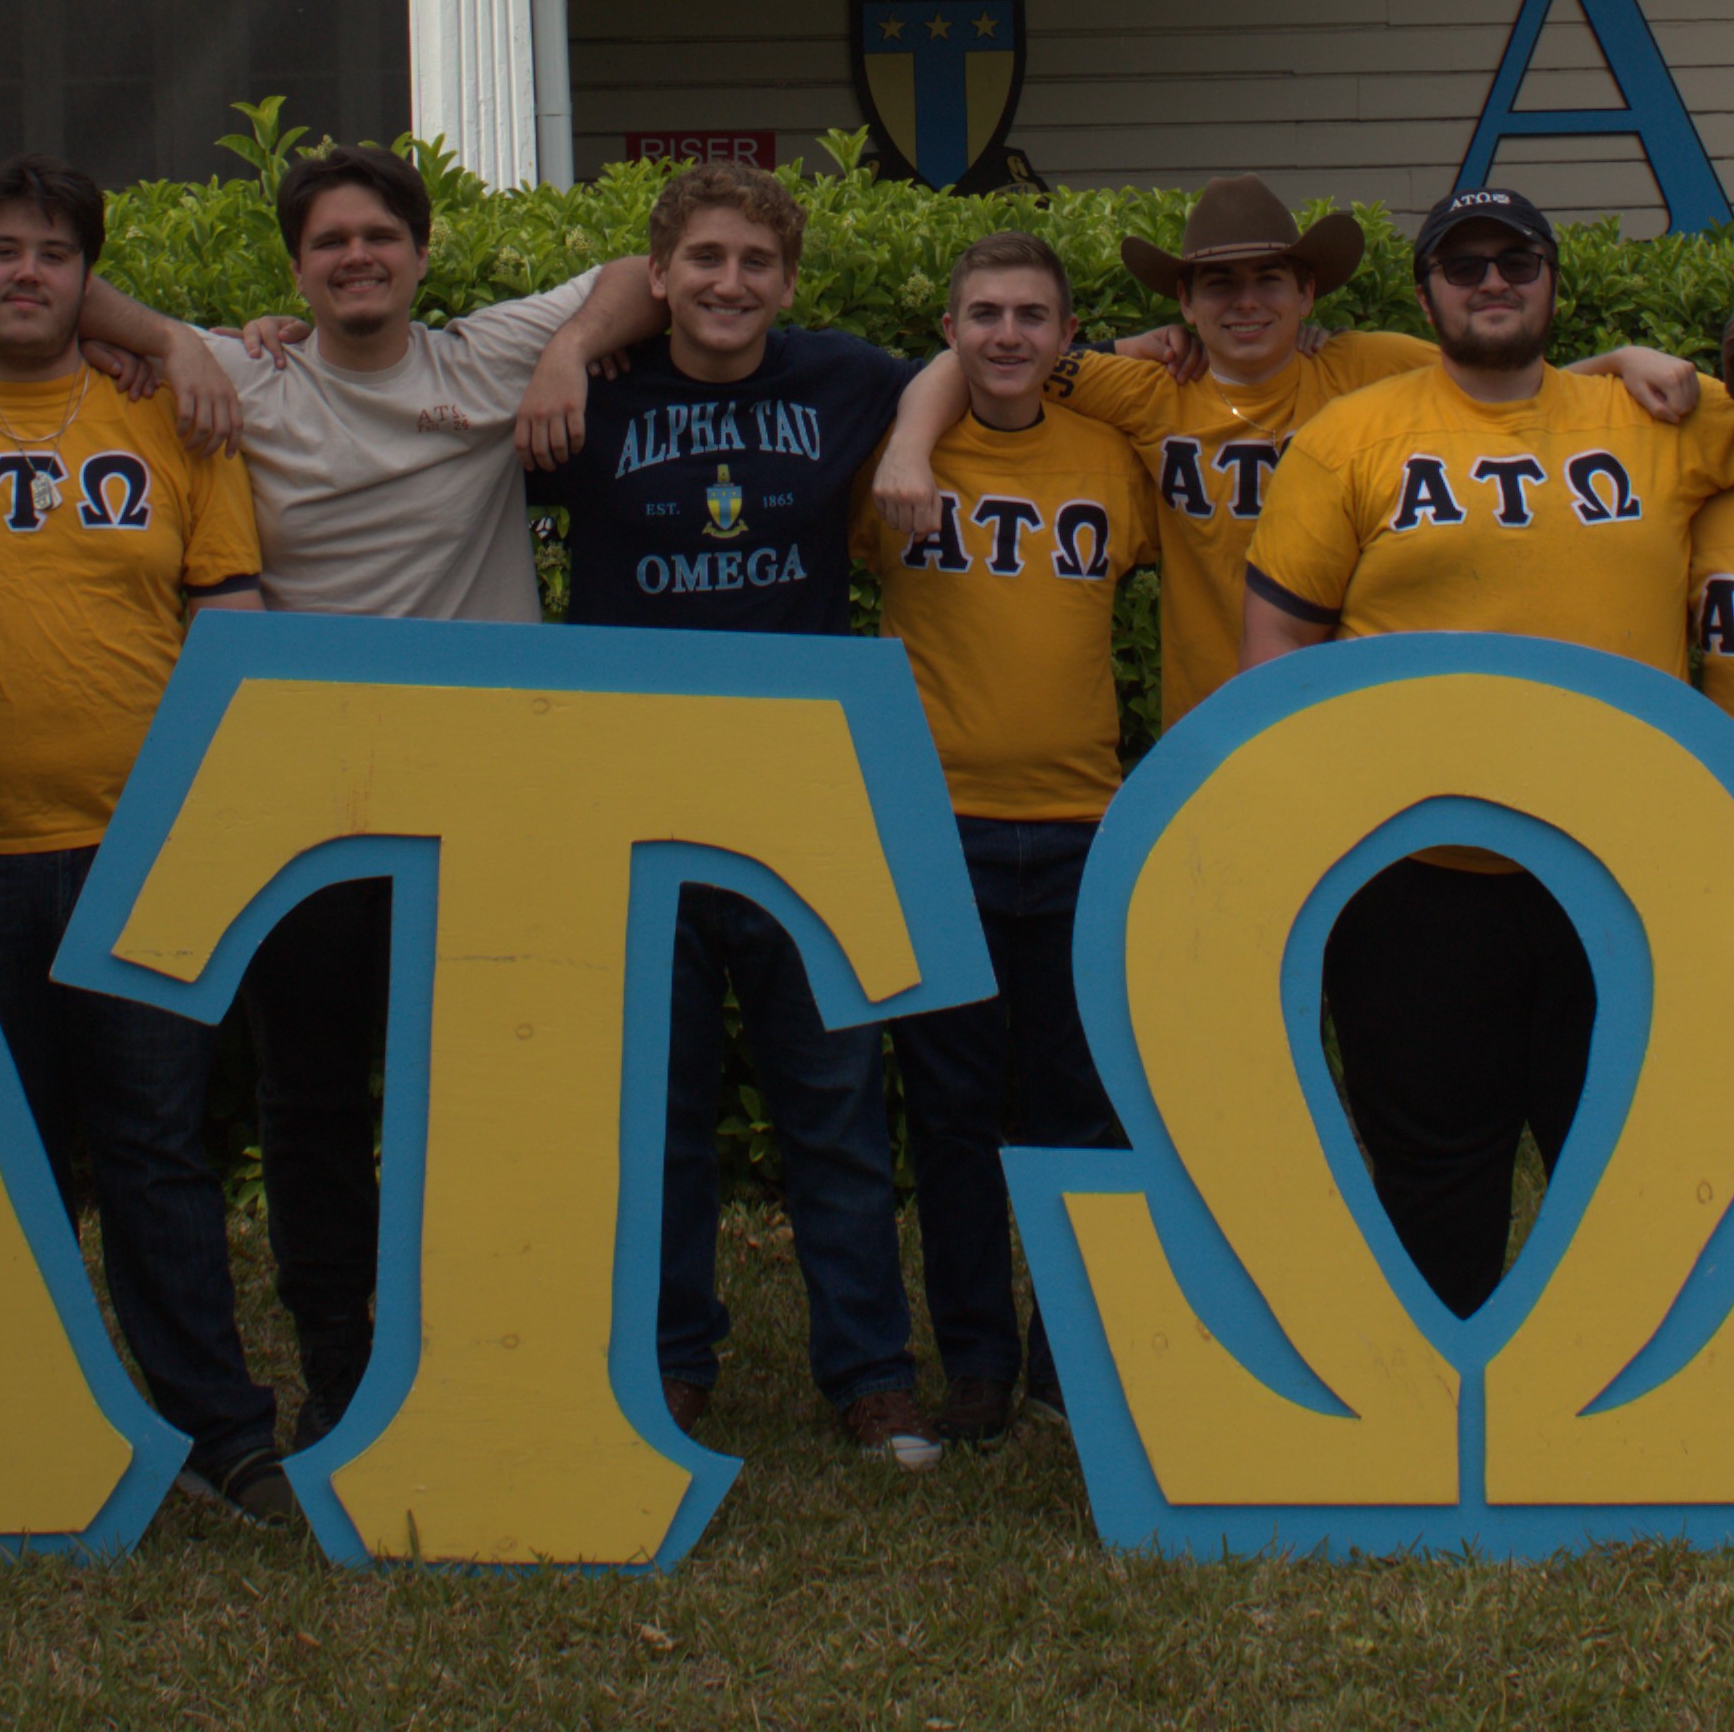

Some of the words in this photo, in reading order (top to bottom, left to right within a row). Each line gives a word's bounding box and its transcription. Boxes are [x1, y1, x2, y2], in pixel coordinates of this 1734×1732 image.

[615, 400, 746, 479] ALPHA
[749, 399, 820, 461] TAU
[645, 501, 681, 516] EST.
[762, 492, 794, 508] 1865
[636, 542, 808, 594] OMEGA
